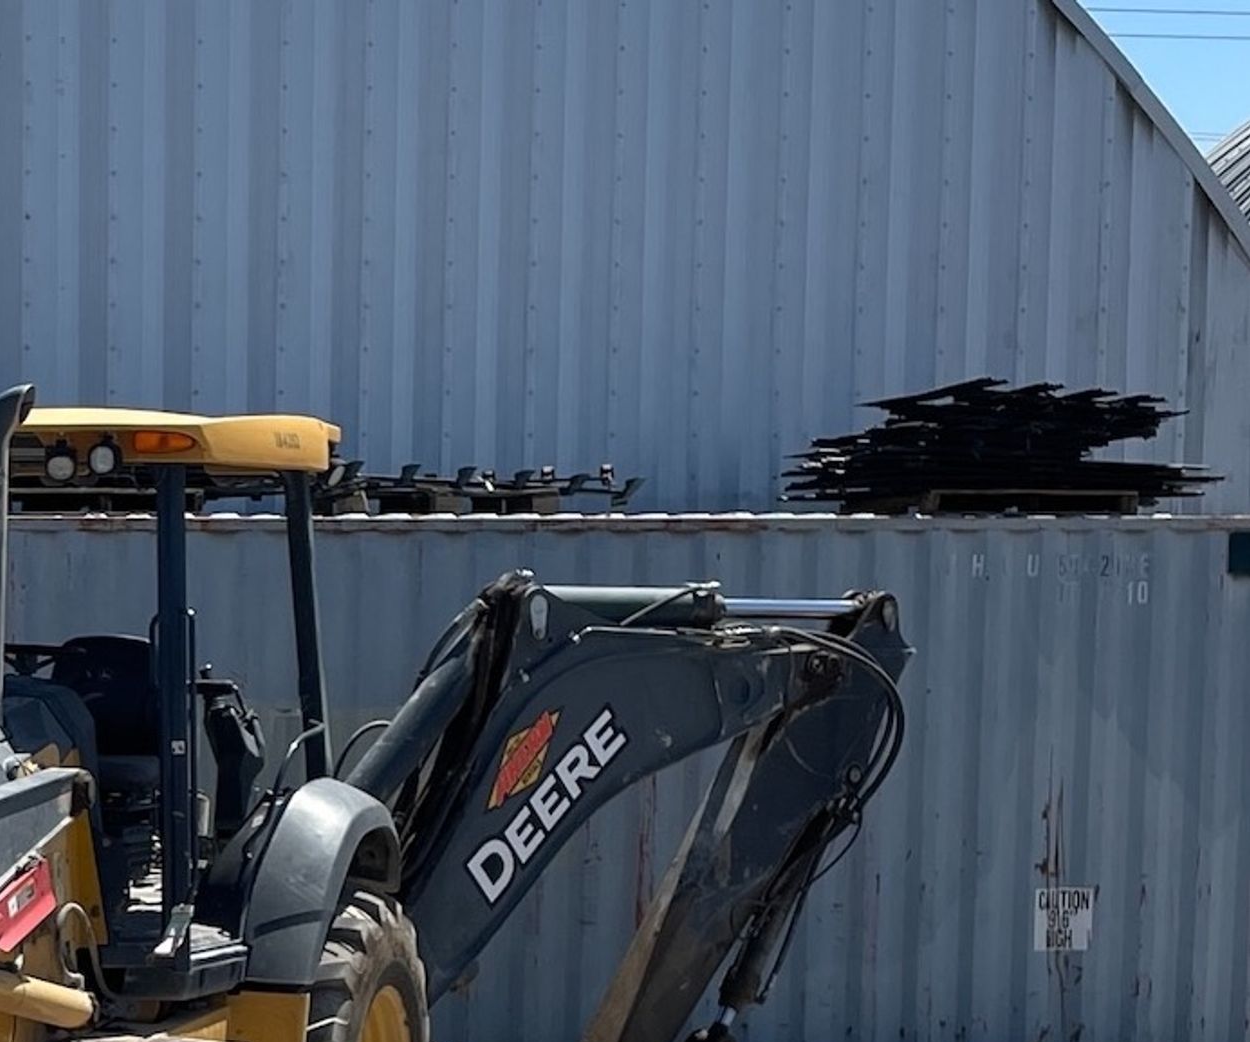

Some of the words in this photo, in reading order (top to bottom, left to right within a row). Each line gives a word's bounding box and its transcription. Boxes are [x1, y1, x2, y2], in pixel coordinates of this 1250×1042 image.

[466, 708, 628, 904] DEERE
[1038, 889, 1090, 911] CAUTION
[1046, 929, 1073, 949] HIGH
